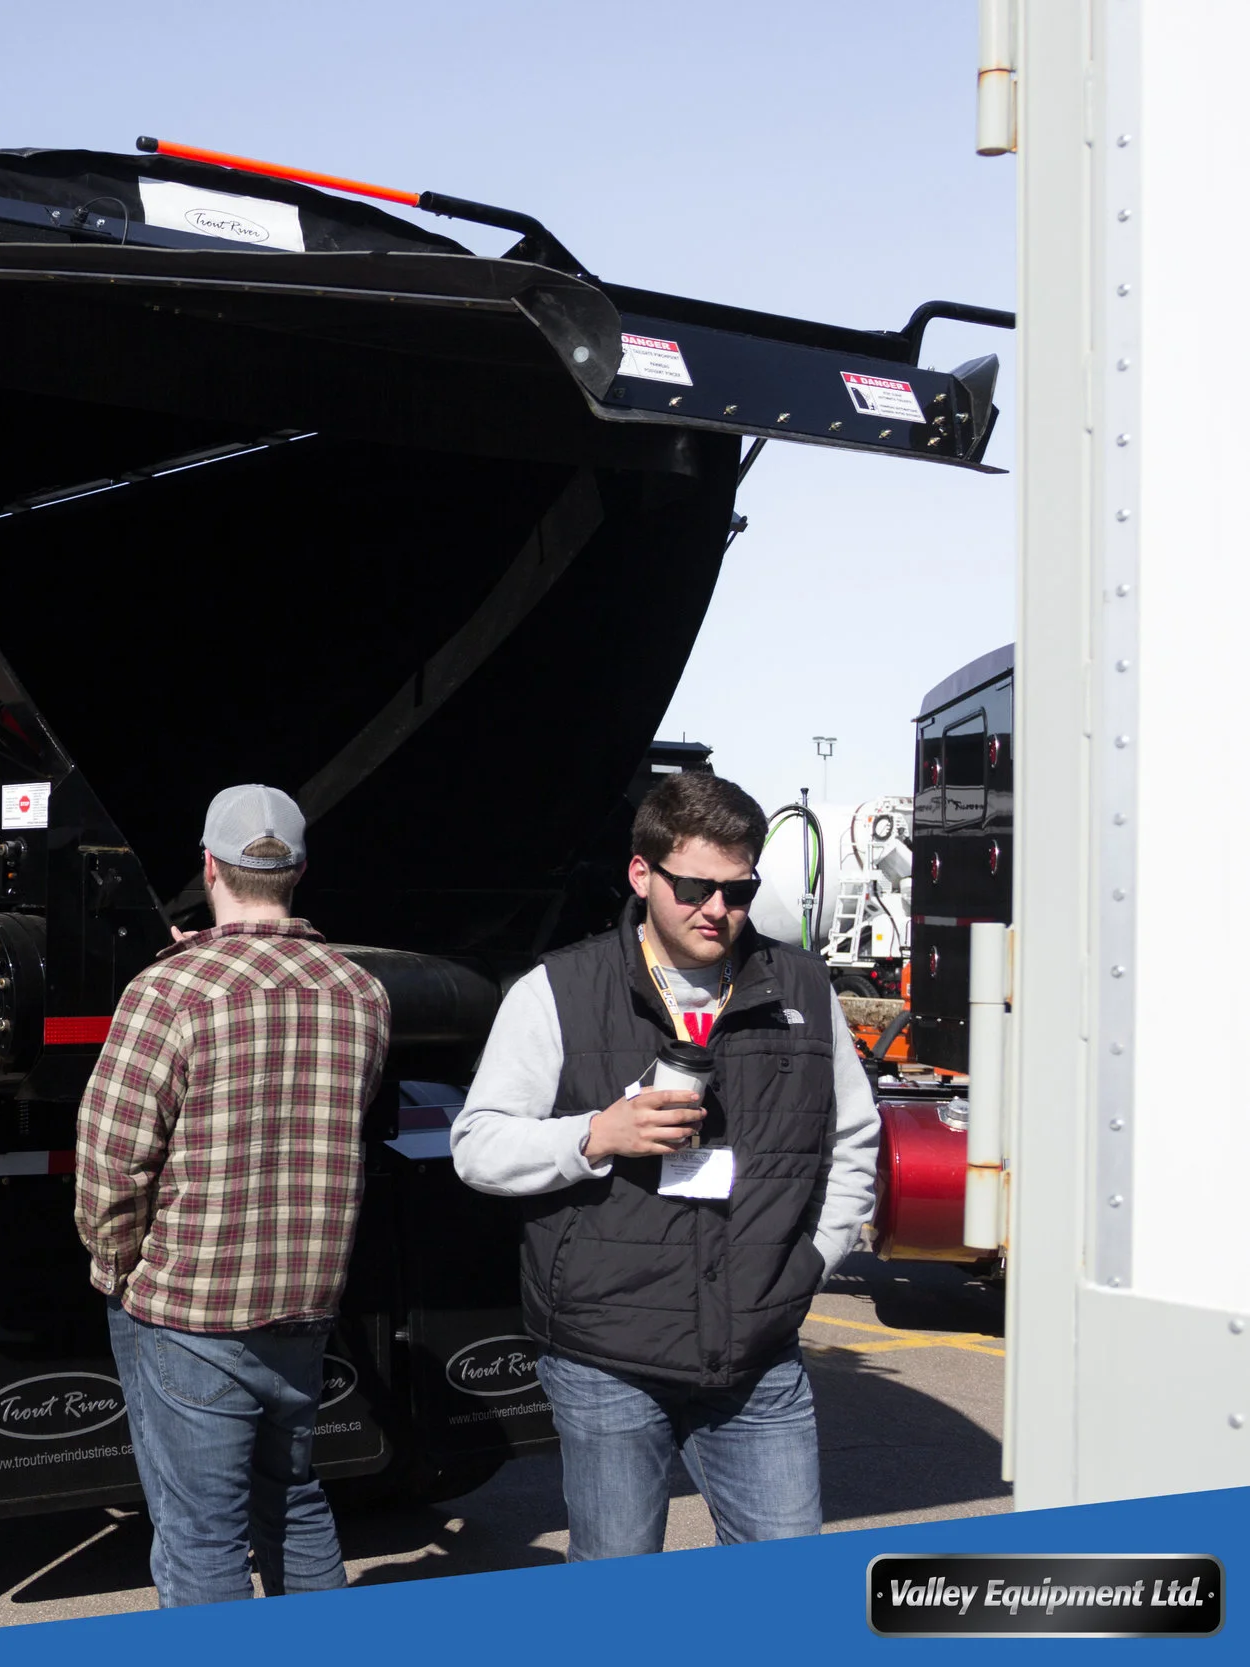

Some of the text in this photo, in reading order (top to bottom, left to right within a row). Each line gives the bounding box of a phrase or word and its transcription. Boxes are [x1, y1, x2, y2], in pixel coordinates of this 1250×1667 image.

[194, 213, 261, 237] Trout River
[621, 335, 671, 350] DANGER
[860, 377, 905, 390] DANGER
[459, 1356, 505, 1380] Trout
[0, 1391, 118, 1422] Trout River
